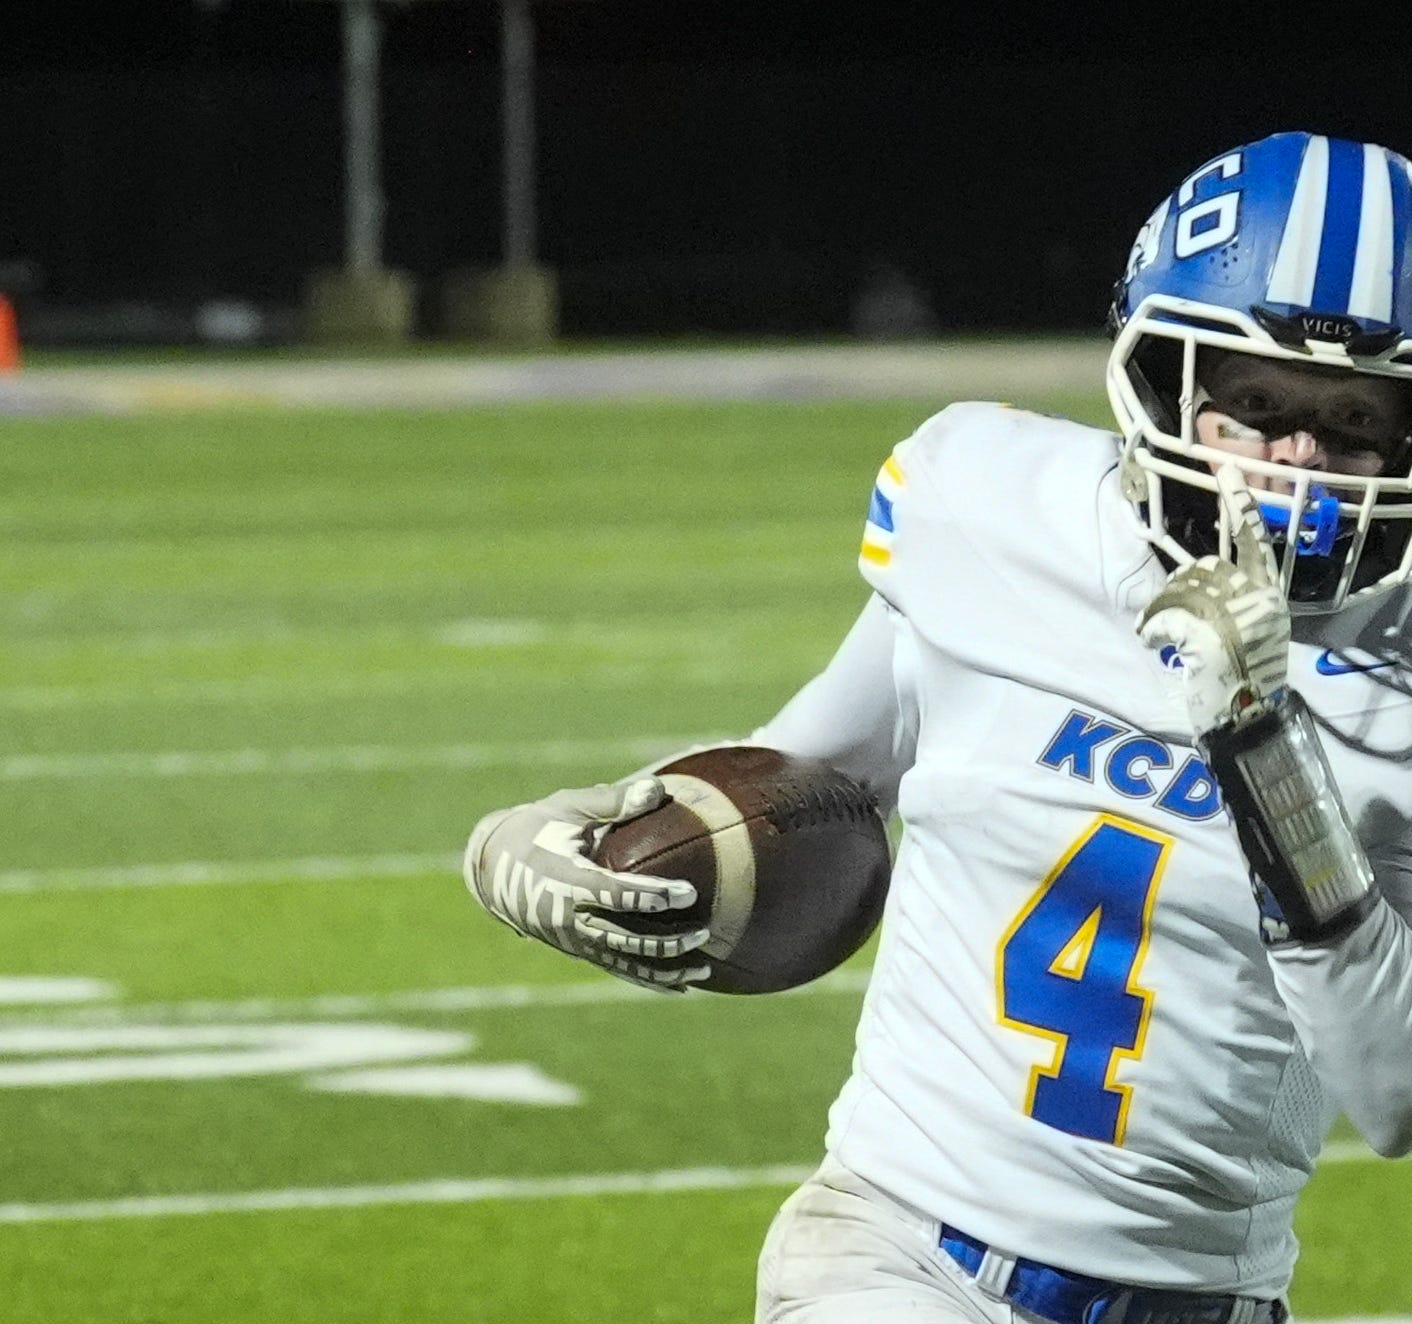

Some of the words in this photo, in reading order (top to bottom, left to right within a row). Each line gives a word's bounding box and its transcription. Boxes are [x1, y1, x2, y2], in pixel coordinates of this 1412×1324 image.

[1302, 317, 1352, 337] VICIS
[1037, 709, 1227, 821] KCD
[997, 812, 1175, 1147] 4
